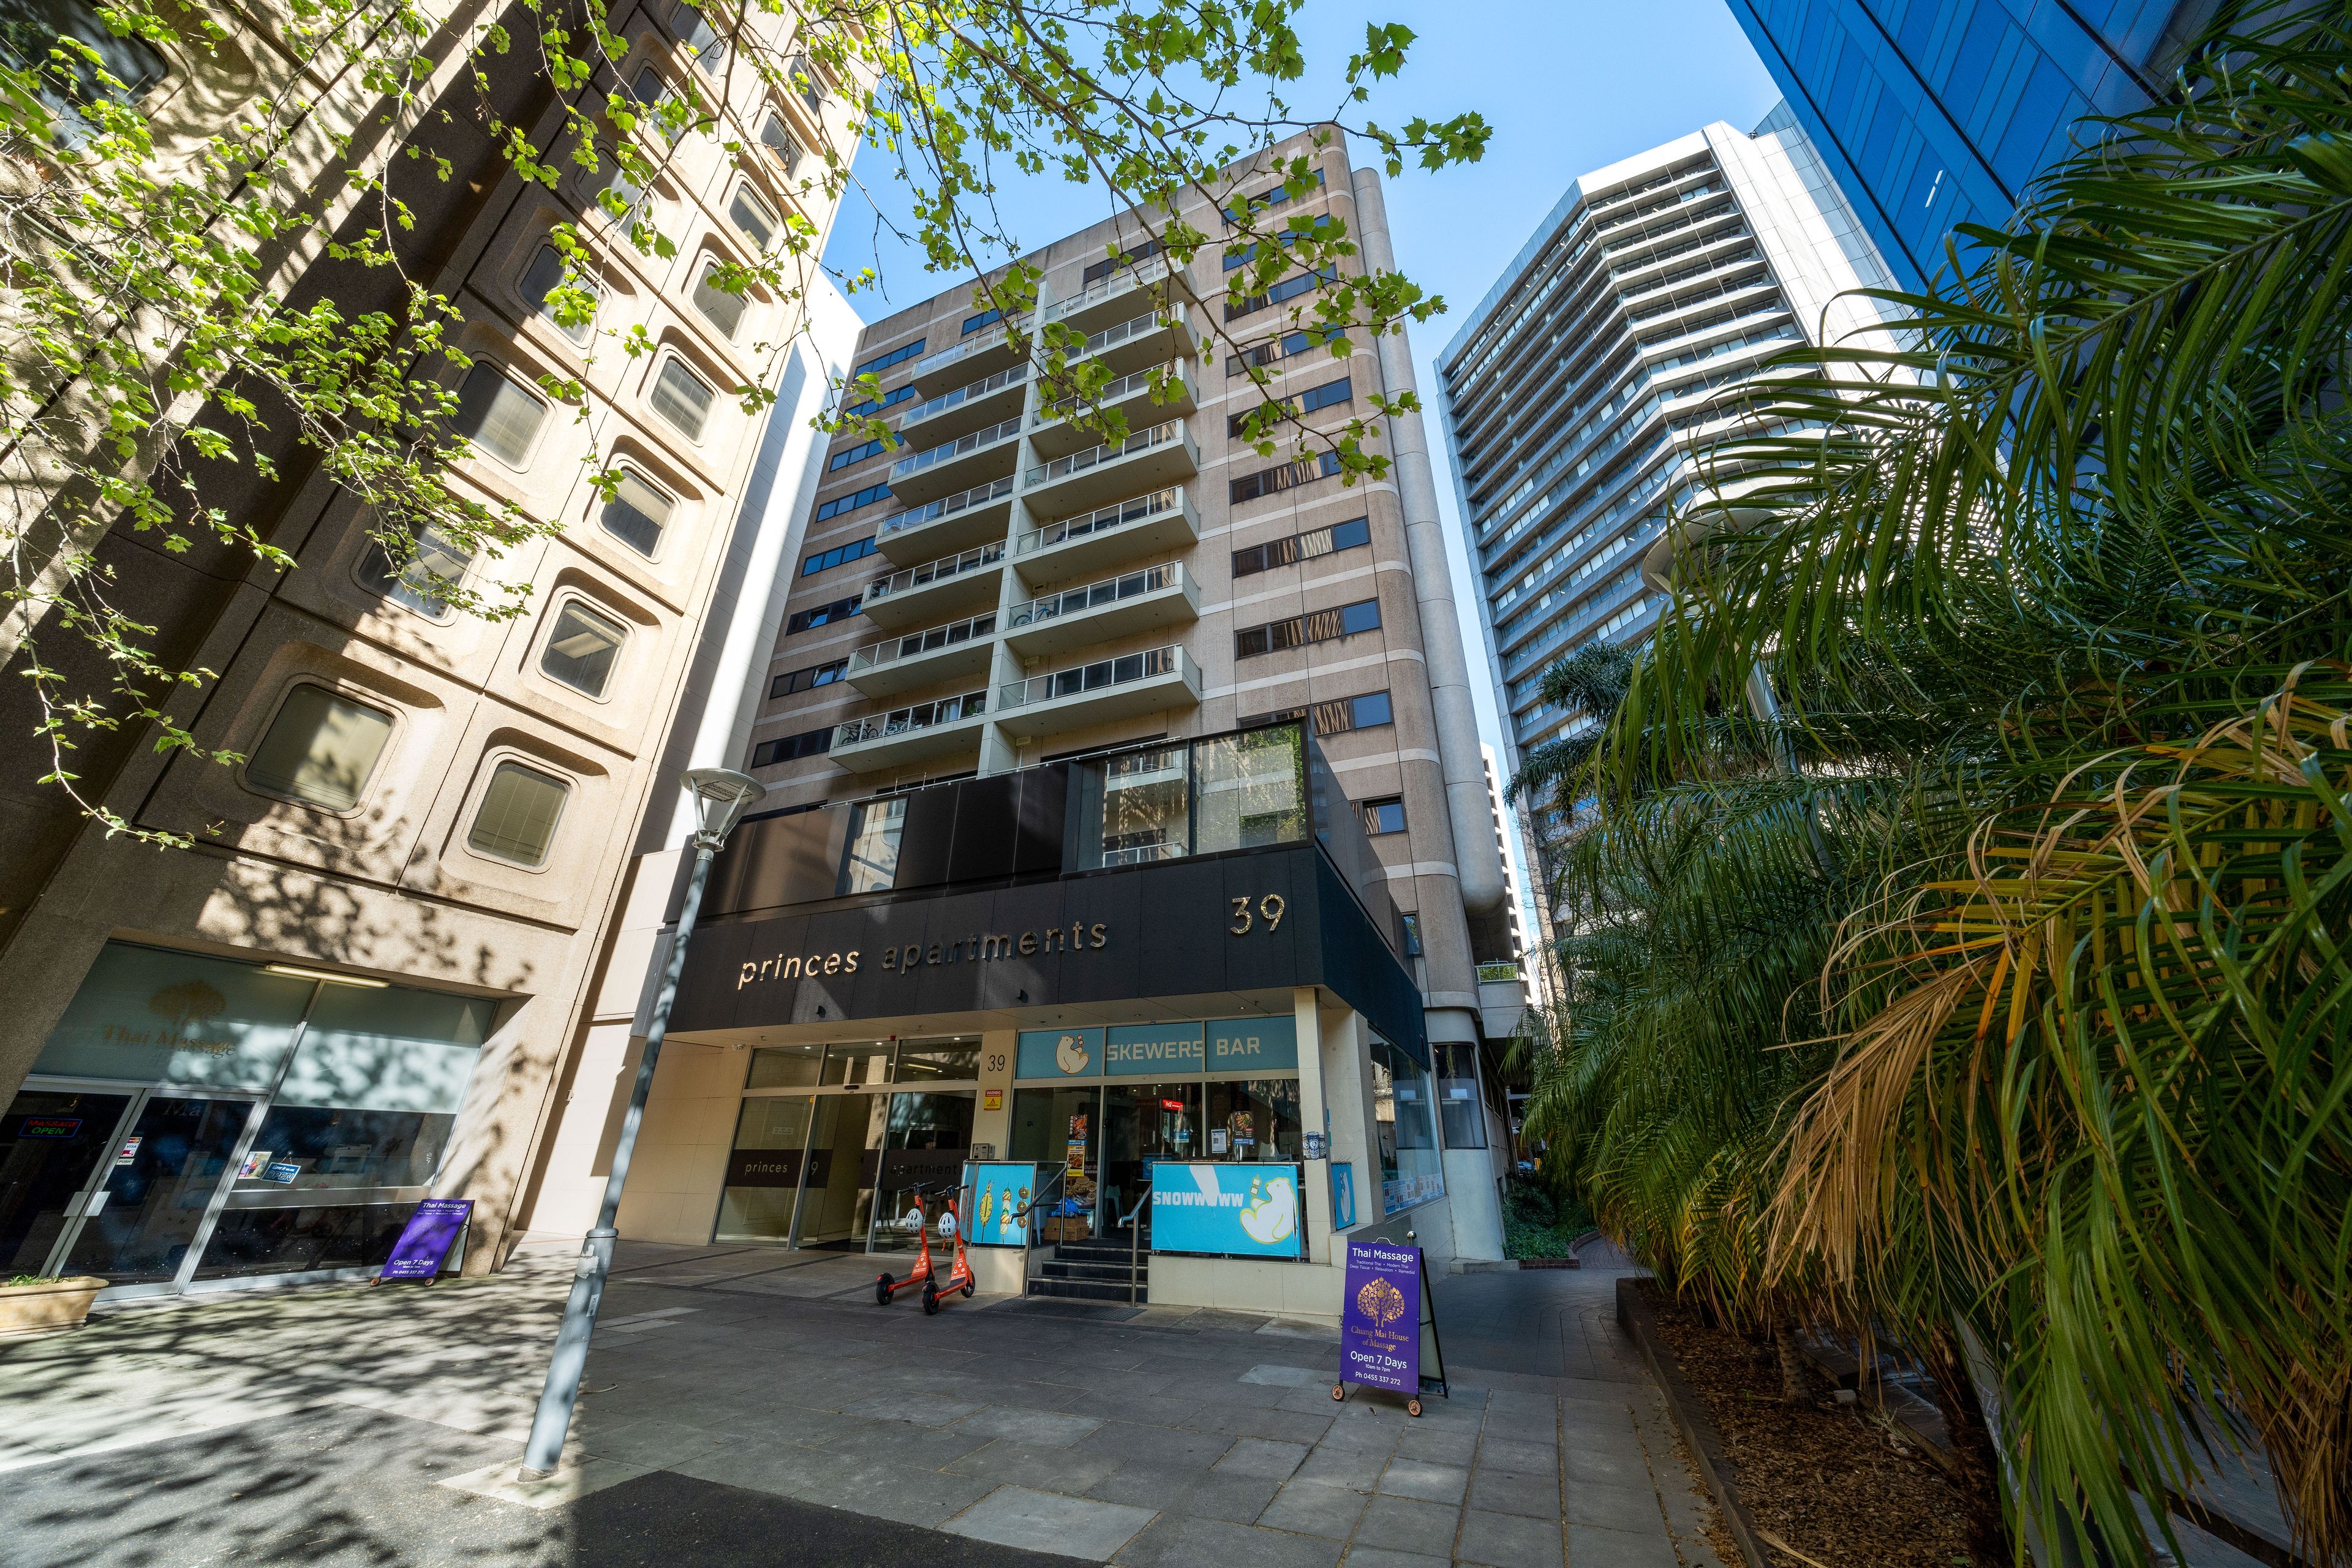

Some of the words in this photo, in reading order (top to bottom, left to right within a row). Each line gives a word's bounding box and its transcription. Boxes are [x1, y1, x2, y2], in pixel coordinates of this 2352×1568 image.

[1231, 894, 1284, 933] 39
[737, 951, 861, 990] princes
[881, 921, 1107, 974] apartments
[102, 1025, 149, 1045] Thai
[156, 1030, 236, 1053] Massage
[1107, 1041, 1203, 1061] SKEWERS
[1216, 1037, 1260, 1056] BAR
[987, 1055, 1005, 1072] 39
[266, 1170, 294, 1181] OPEN
[744, 1161, 788, 1176] princes
[811, 1161, 818, 1175] 9
[1352, 1248, 1371, 1257] Thai
[1374, 1250, 1414, 1262] Massage
[1351, 1325, 1373, 1338] Chiang
[1374, 1329, 1387, 1338] Mai
[1389, 1331, 1409, 1341] House
[1370, 1339, 1396, 1352] Massage
[1351, 1351, 1374, 1363] Open
[1377, 1355, 1382, 1364] 7
[1385, 1356, 1407, 1370] Days
